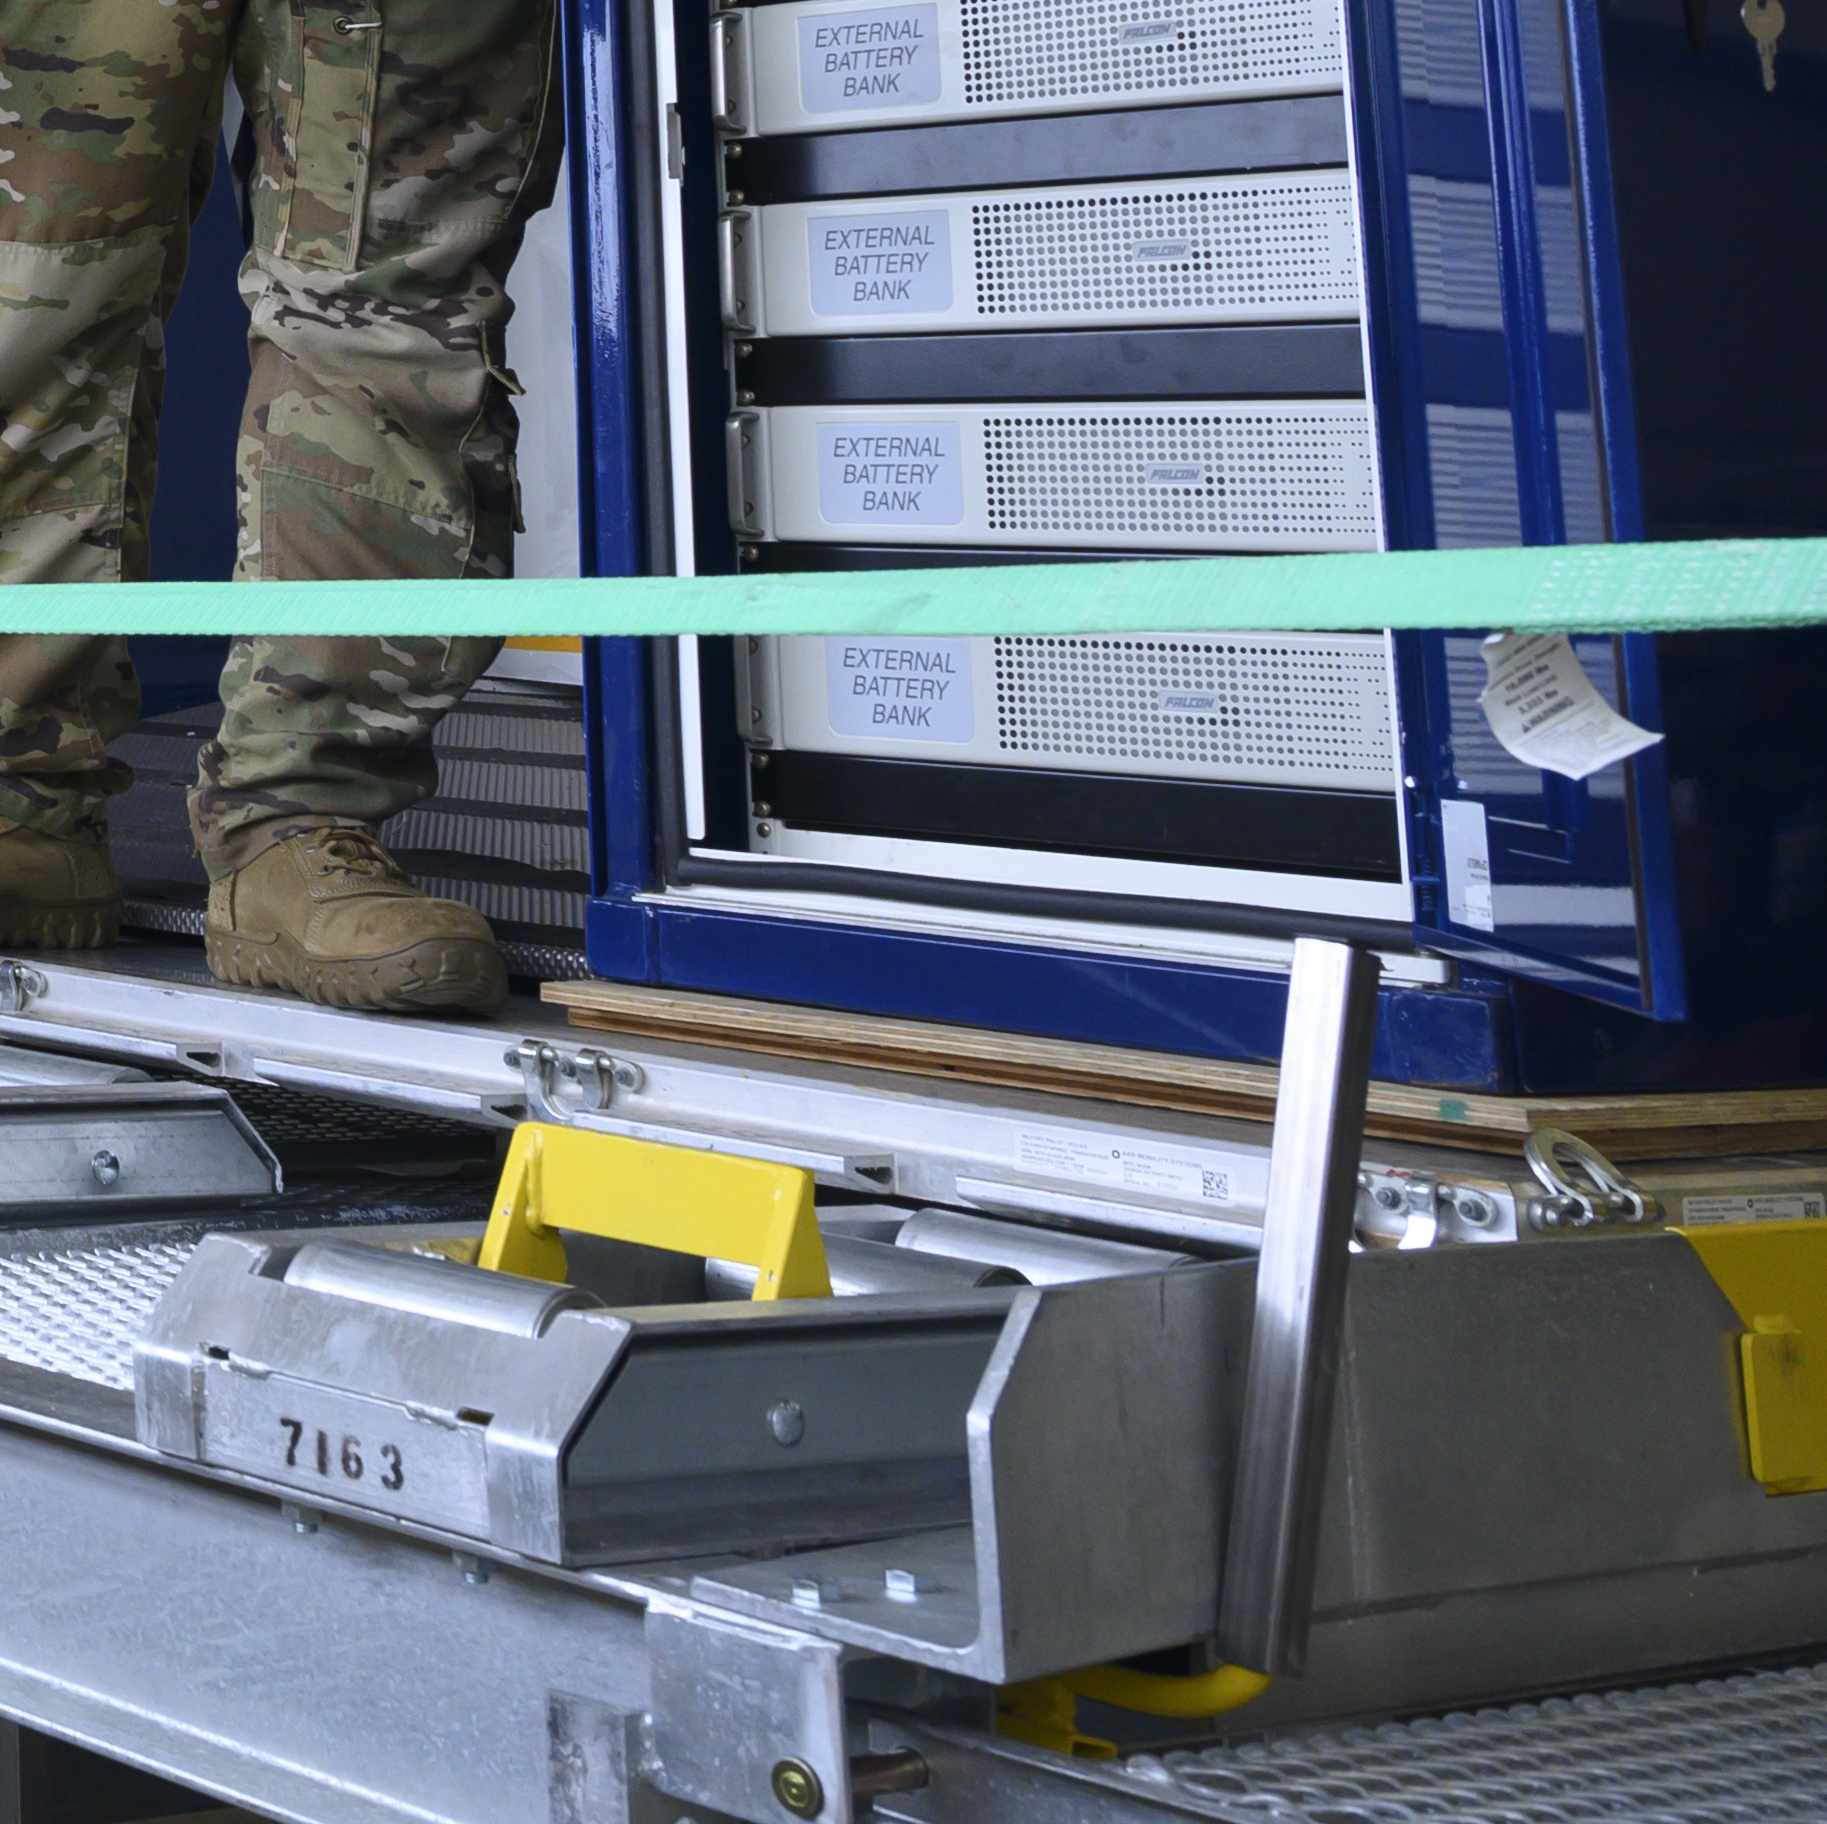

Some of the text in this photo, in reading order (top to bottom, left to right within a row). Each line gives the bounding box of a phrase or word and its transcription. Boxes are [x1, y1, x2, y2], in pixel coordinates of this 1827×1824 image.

[815, 18, 924, 48] EXTERNAL
[1123, 22, 1171, 40] FALCON
[824, 45, 919, 73] BATTERY
[843, 73, 900, 97] BANK
[824, 225, 935, 251] EXTERNAL
[1136, 244, 1187, 258] FALCON
[834, 252, 929, 276] BATTERY
[853, 280, 912, 302] BANK
[833, 437, 945, 458] EXTERNAL
[843, 464, 938, 484] BATTERY
[1150, 469, 1200, 481] FALCON
[863, 490, 922, 511] BANK
[843, 647, 956, 674] EXTERNAL
[852, 675, 949, 700] BATTERY
[1163, 695, 1215, 709] FALCON
[872, 703, 932, 727] BANK
[1137, 1153, 1168, 1163] MOBILITY
[1170, 1158, 1202, 1169] SYSTEMS
[280, 1416, 404, 1491] 7163
